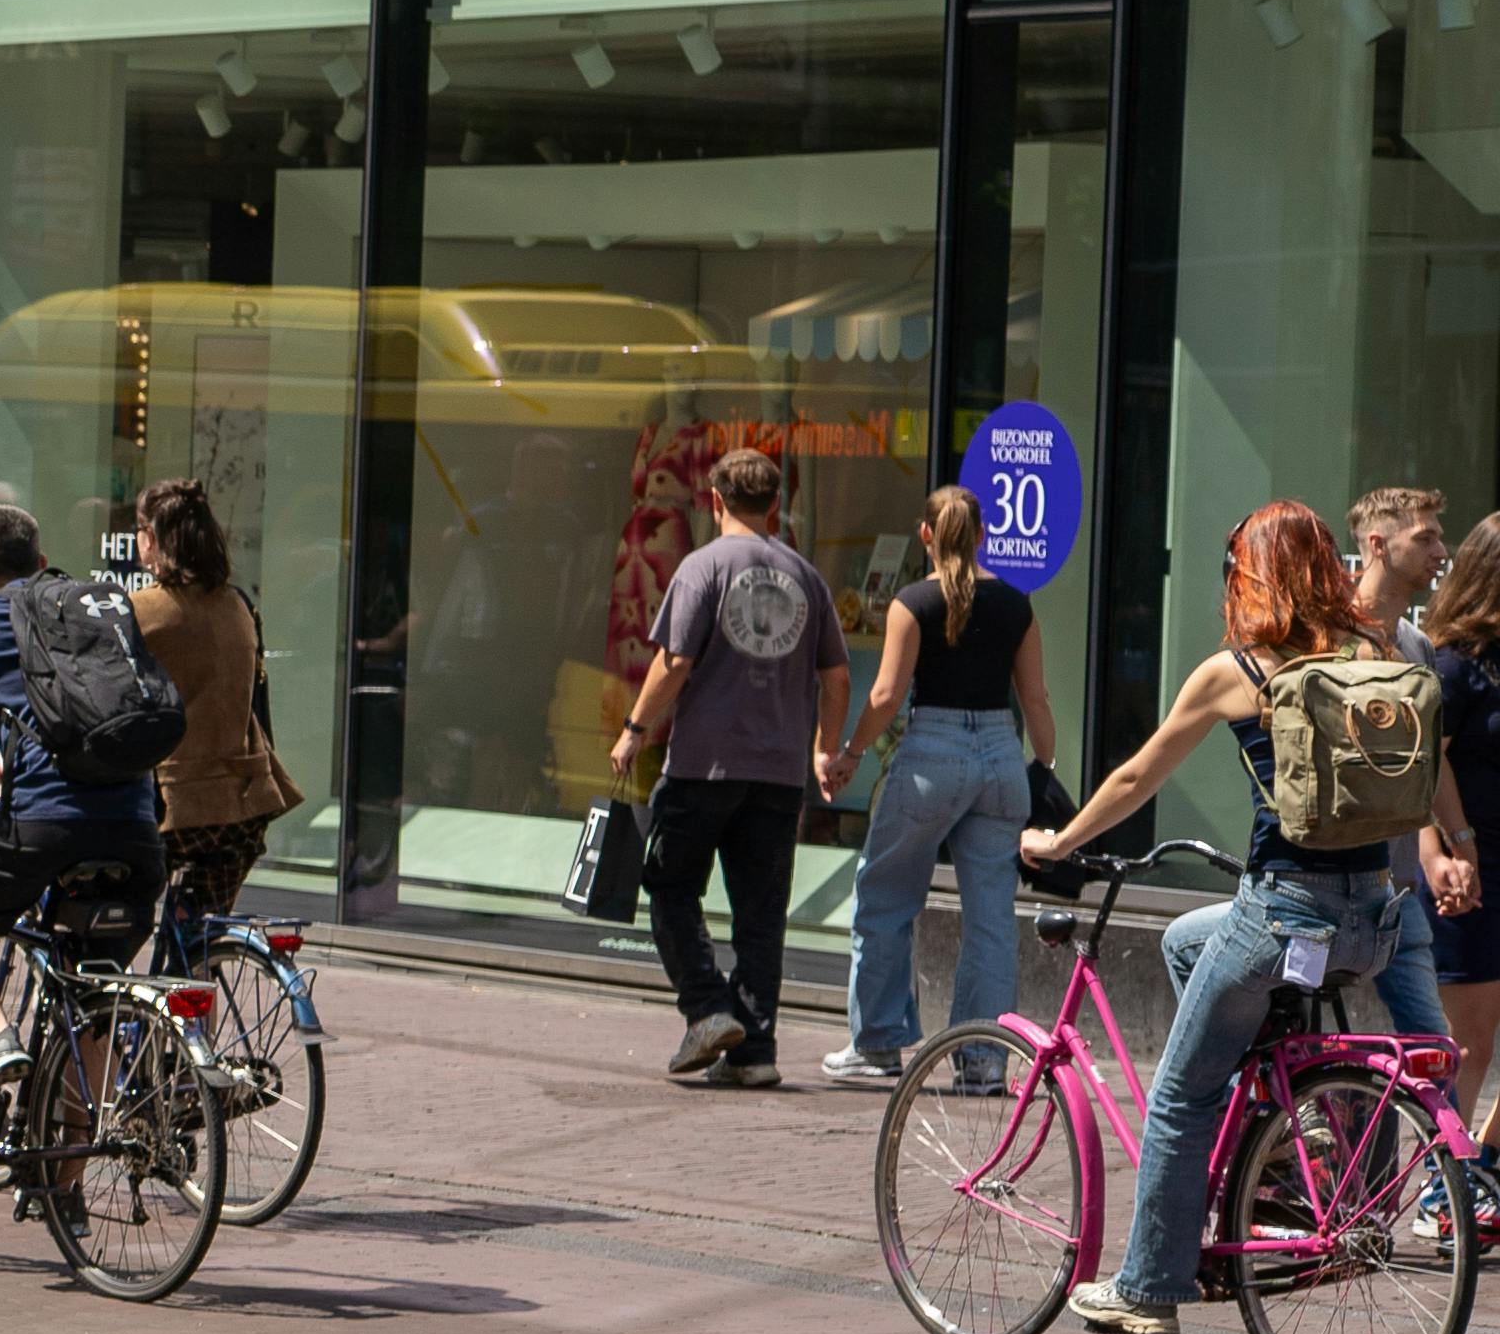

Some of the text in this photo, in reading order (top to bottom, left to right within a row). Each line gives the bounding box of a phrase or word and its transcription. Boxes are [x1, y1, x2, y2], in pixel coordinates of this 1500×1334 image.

[991, 428, 1054, 449] BIJZONDER
[990, 445, 1052, 465] VOORDEEL
[101, 532, 136, 561] HET
[986, 536, 1047, 560] KORTING
